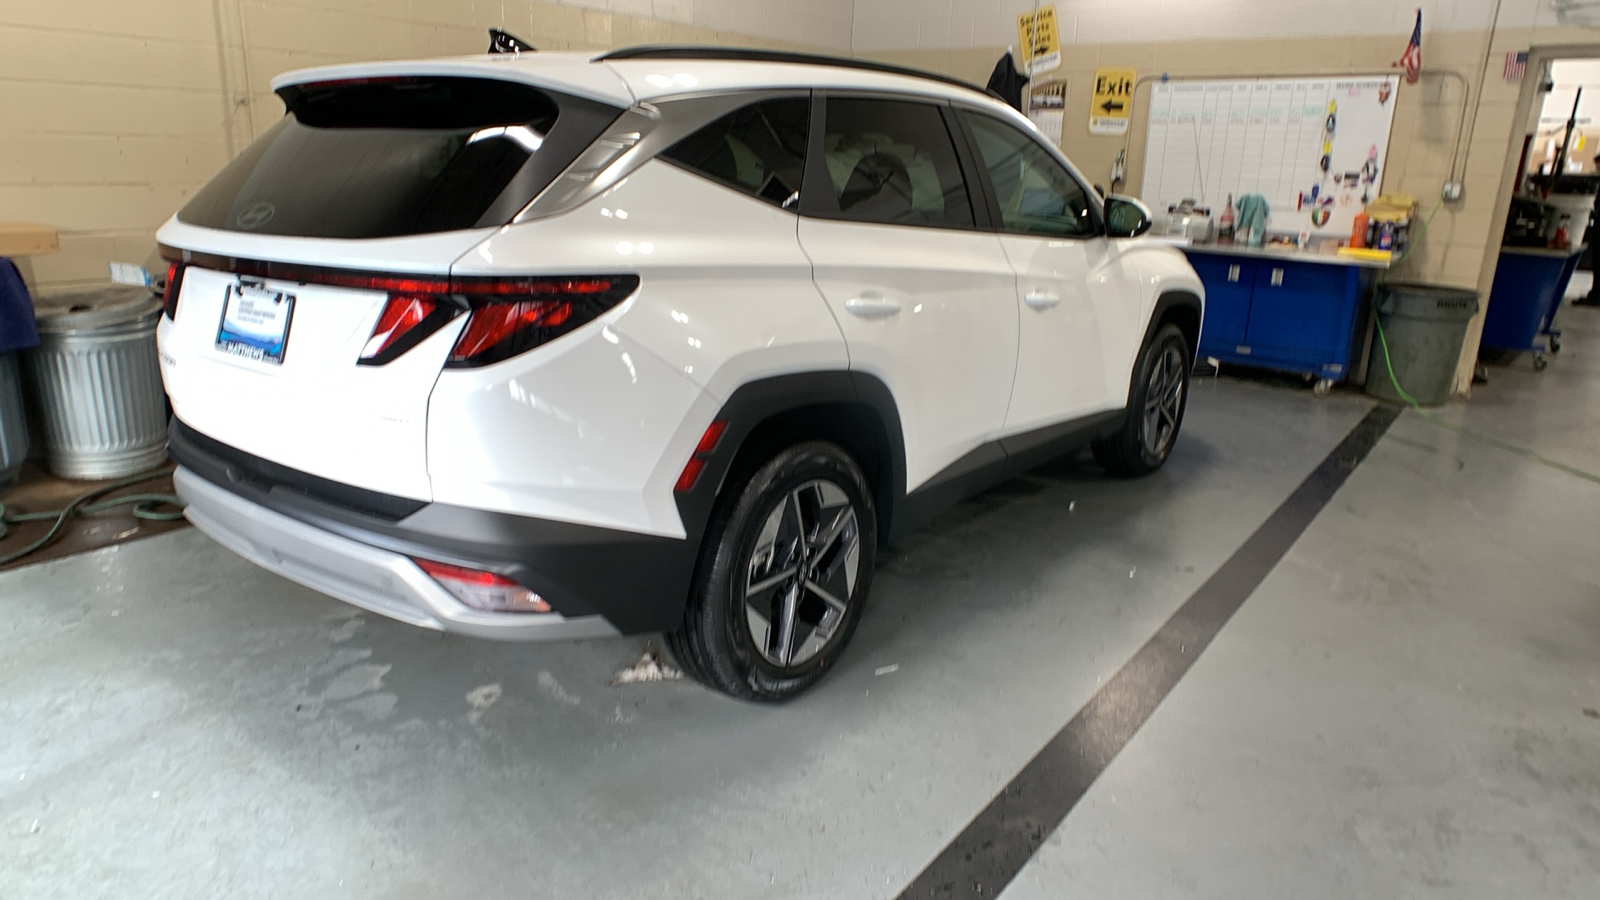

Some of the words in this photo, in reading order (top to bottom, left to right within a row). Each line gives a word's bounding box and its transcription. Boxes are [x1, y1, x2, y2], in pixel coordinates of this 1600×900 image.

[1020, 9, 1053, 28] Service
[1096, 76, 1133, 97] Exit
[227, 340, 264, 360] MATTHEWS
